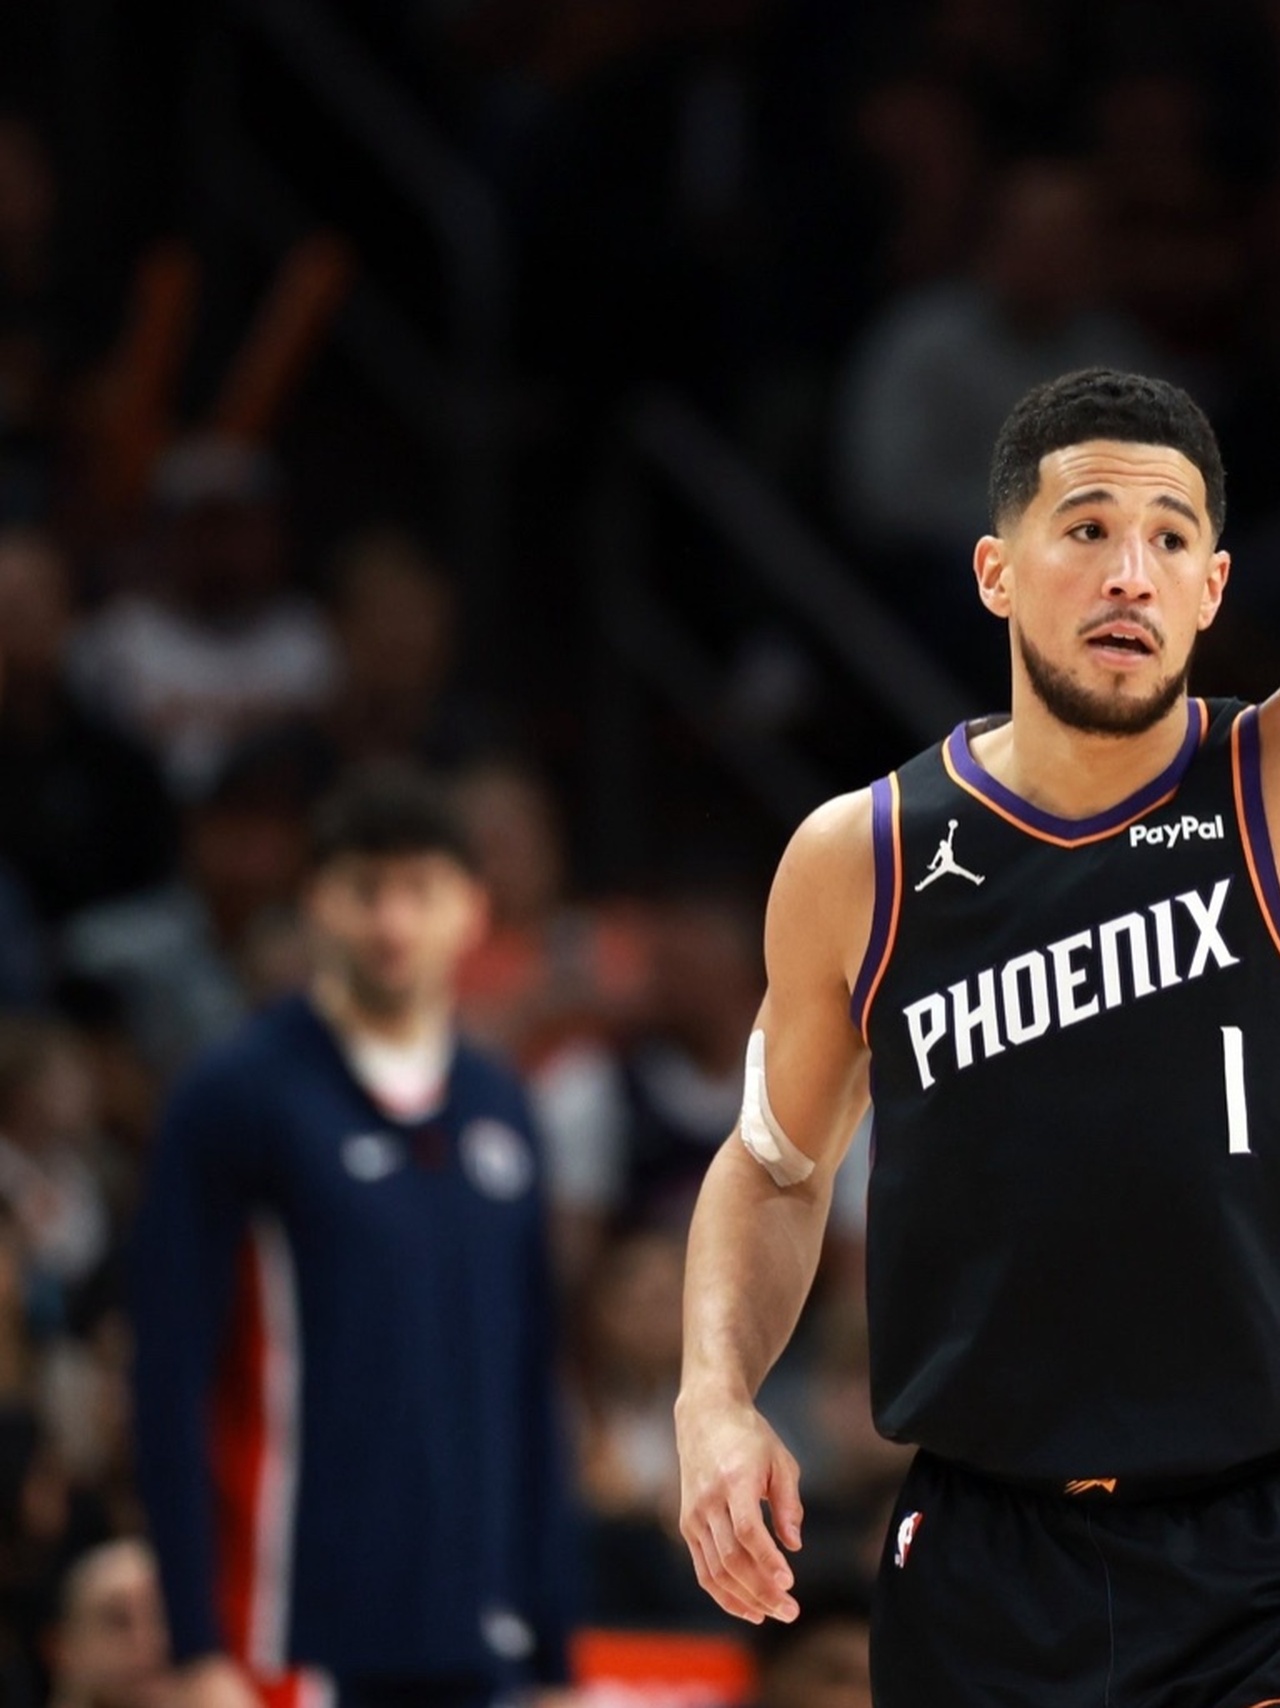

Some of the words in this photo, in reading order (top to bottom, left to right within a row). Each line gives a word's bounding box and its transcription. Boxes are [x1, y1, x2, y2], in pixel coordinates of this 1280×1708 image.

[1129, 814, 1225, 849] PayPal
[903, 878, 1241, 1091] PHOENIX
[1220, 1025, 1252, 1155] 1
